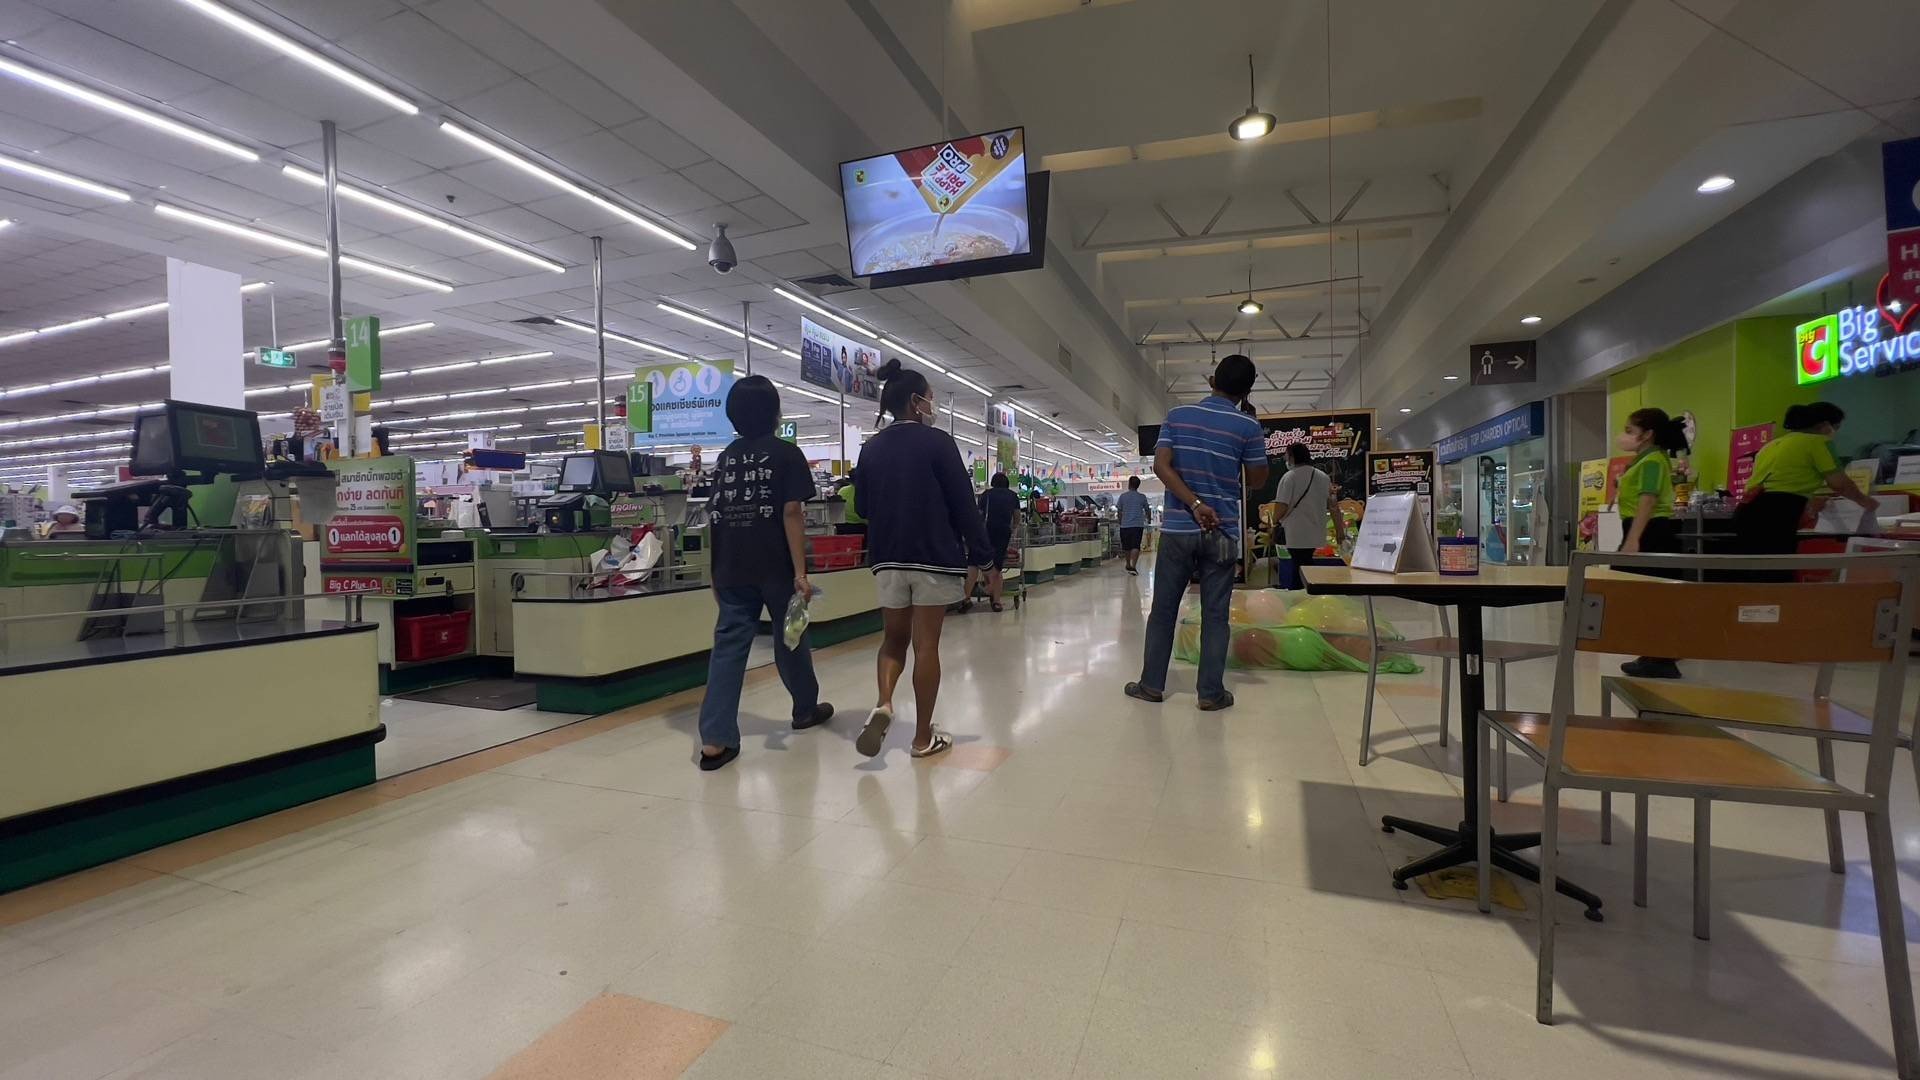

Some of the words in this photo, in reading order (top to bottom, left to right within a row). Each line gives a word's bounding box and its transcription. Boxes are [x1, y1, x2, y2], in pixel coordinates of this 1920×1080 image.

[942, 148, 970, 173] PRO
[350, 321, 369, 347] 14
[1839, 305, 1880, 344] Big
[630, 384, 645, 403] 15
[780, 423, 794, 437] 16
[1504, 415, 1529, 435] OPTICAL
[329, 579, 341, 591] Big
[343, 579, 350, 589] C
